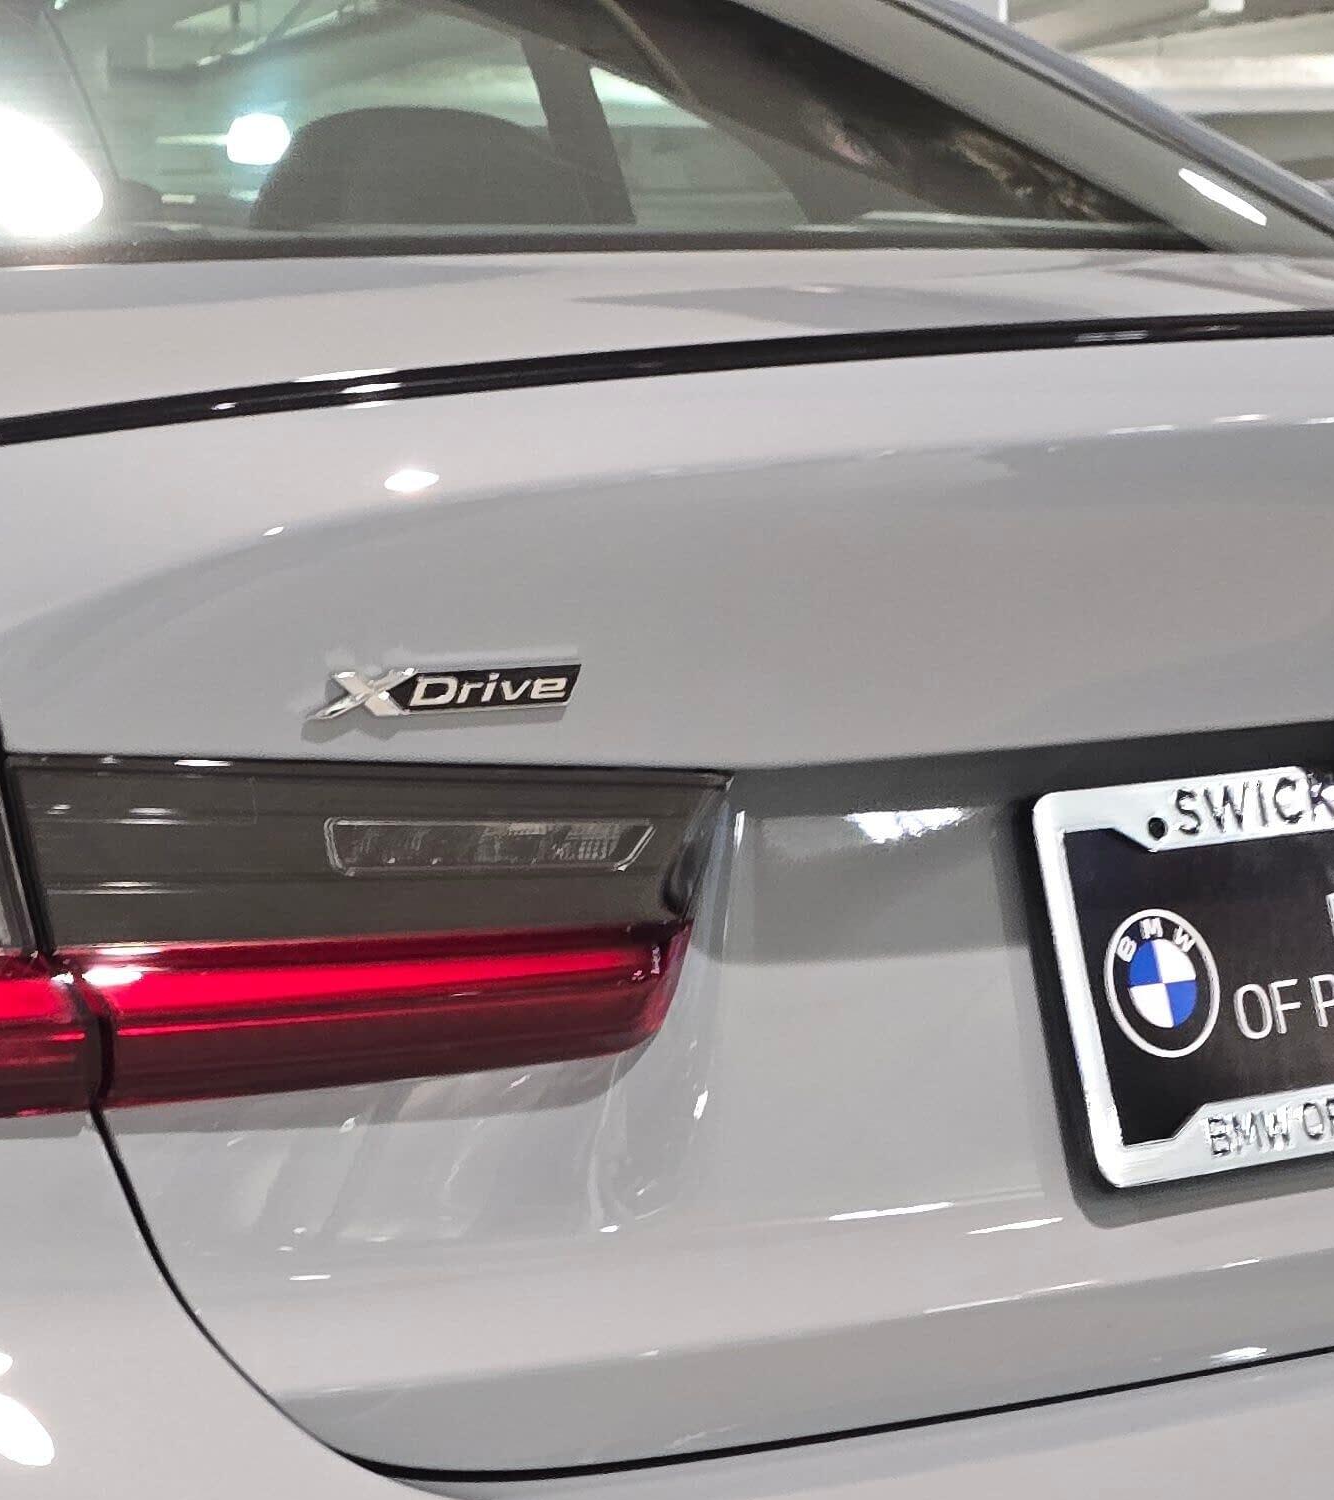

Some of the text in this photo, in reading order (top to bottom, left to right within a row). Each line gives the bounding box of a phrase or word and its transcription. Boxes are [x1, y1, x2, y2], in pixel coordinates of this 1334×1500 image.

[1116, 915, 1198, 964] BMW
[1233, 978, 1301, 1040] OF
[1206, 1102, 1293, 1158] BMW
